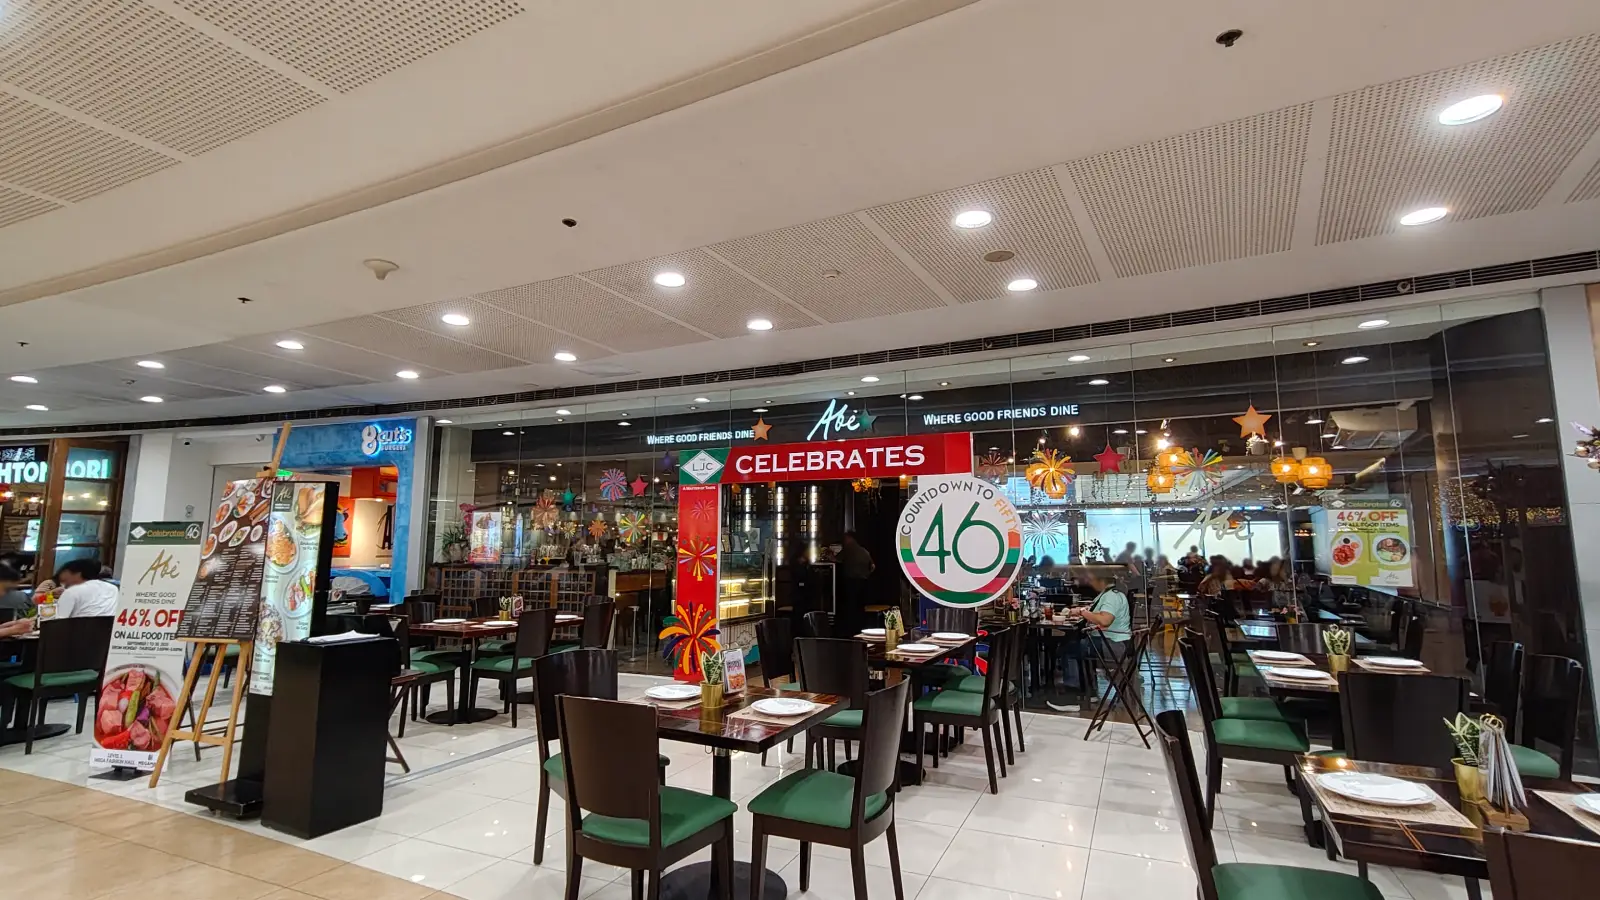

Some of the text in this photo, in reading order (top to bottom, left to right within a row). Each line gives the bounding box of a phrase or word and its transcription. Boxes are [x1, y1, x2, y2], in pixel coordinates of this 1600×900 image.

[964, 411, 995, 422] GOOD
[997, 406, 1047, 420] FRIENDS
[1050, 404, 1079, 417] DINE
[675, 433, 698, 443] GOOD
[698, 431, 732, 441] FRIENDS
[734, 429, 755, 439] DINE
[692, 462, 714, 472] LJC
[735, 444, 925, 474] CELEBRATES
[901, 480, 1020, 536] COUNTDOWN TO FIFTY
[1336, 511, 1399, 522] 46% OFF
[916, 501, 1005, 574] 46
[158, 591, 177, 599] GOOD
[117, 608, 151, 627] 46%
[114, 630, 126, 639] ON
[126, 631, 140, 640] ALL
[140, 631, 163, 640] FOOD
